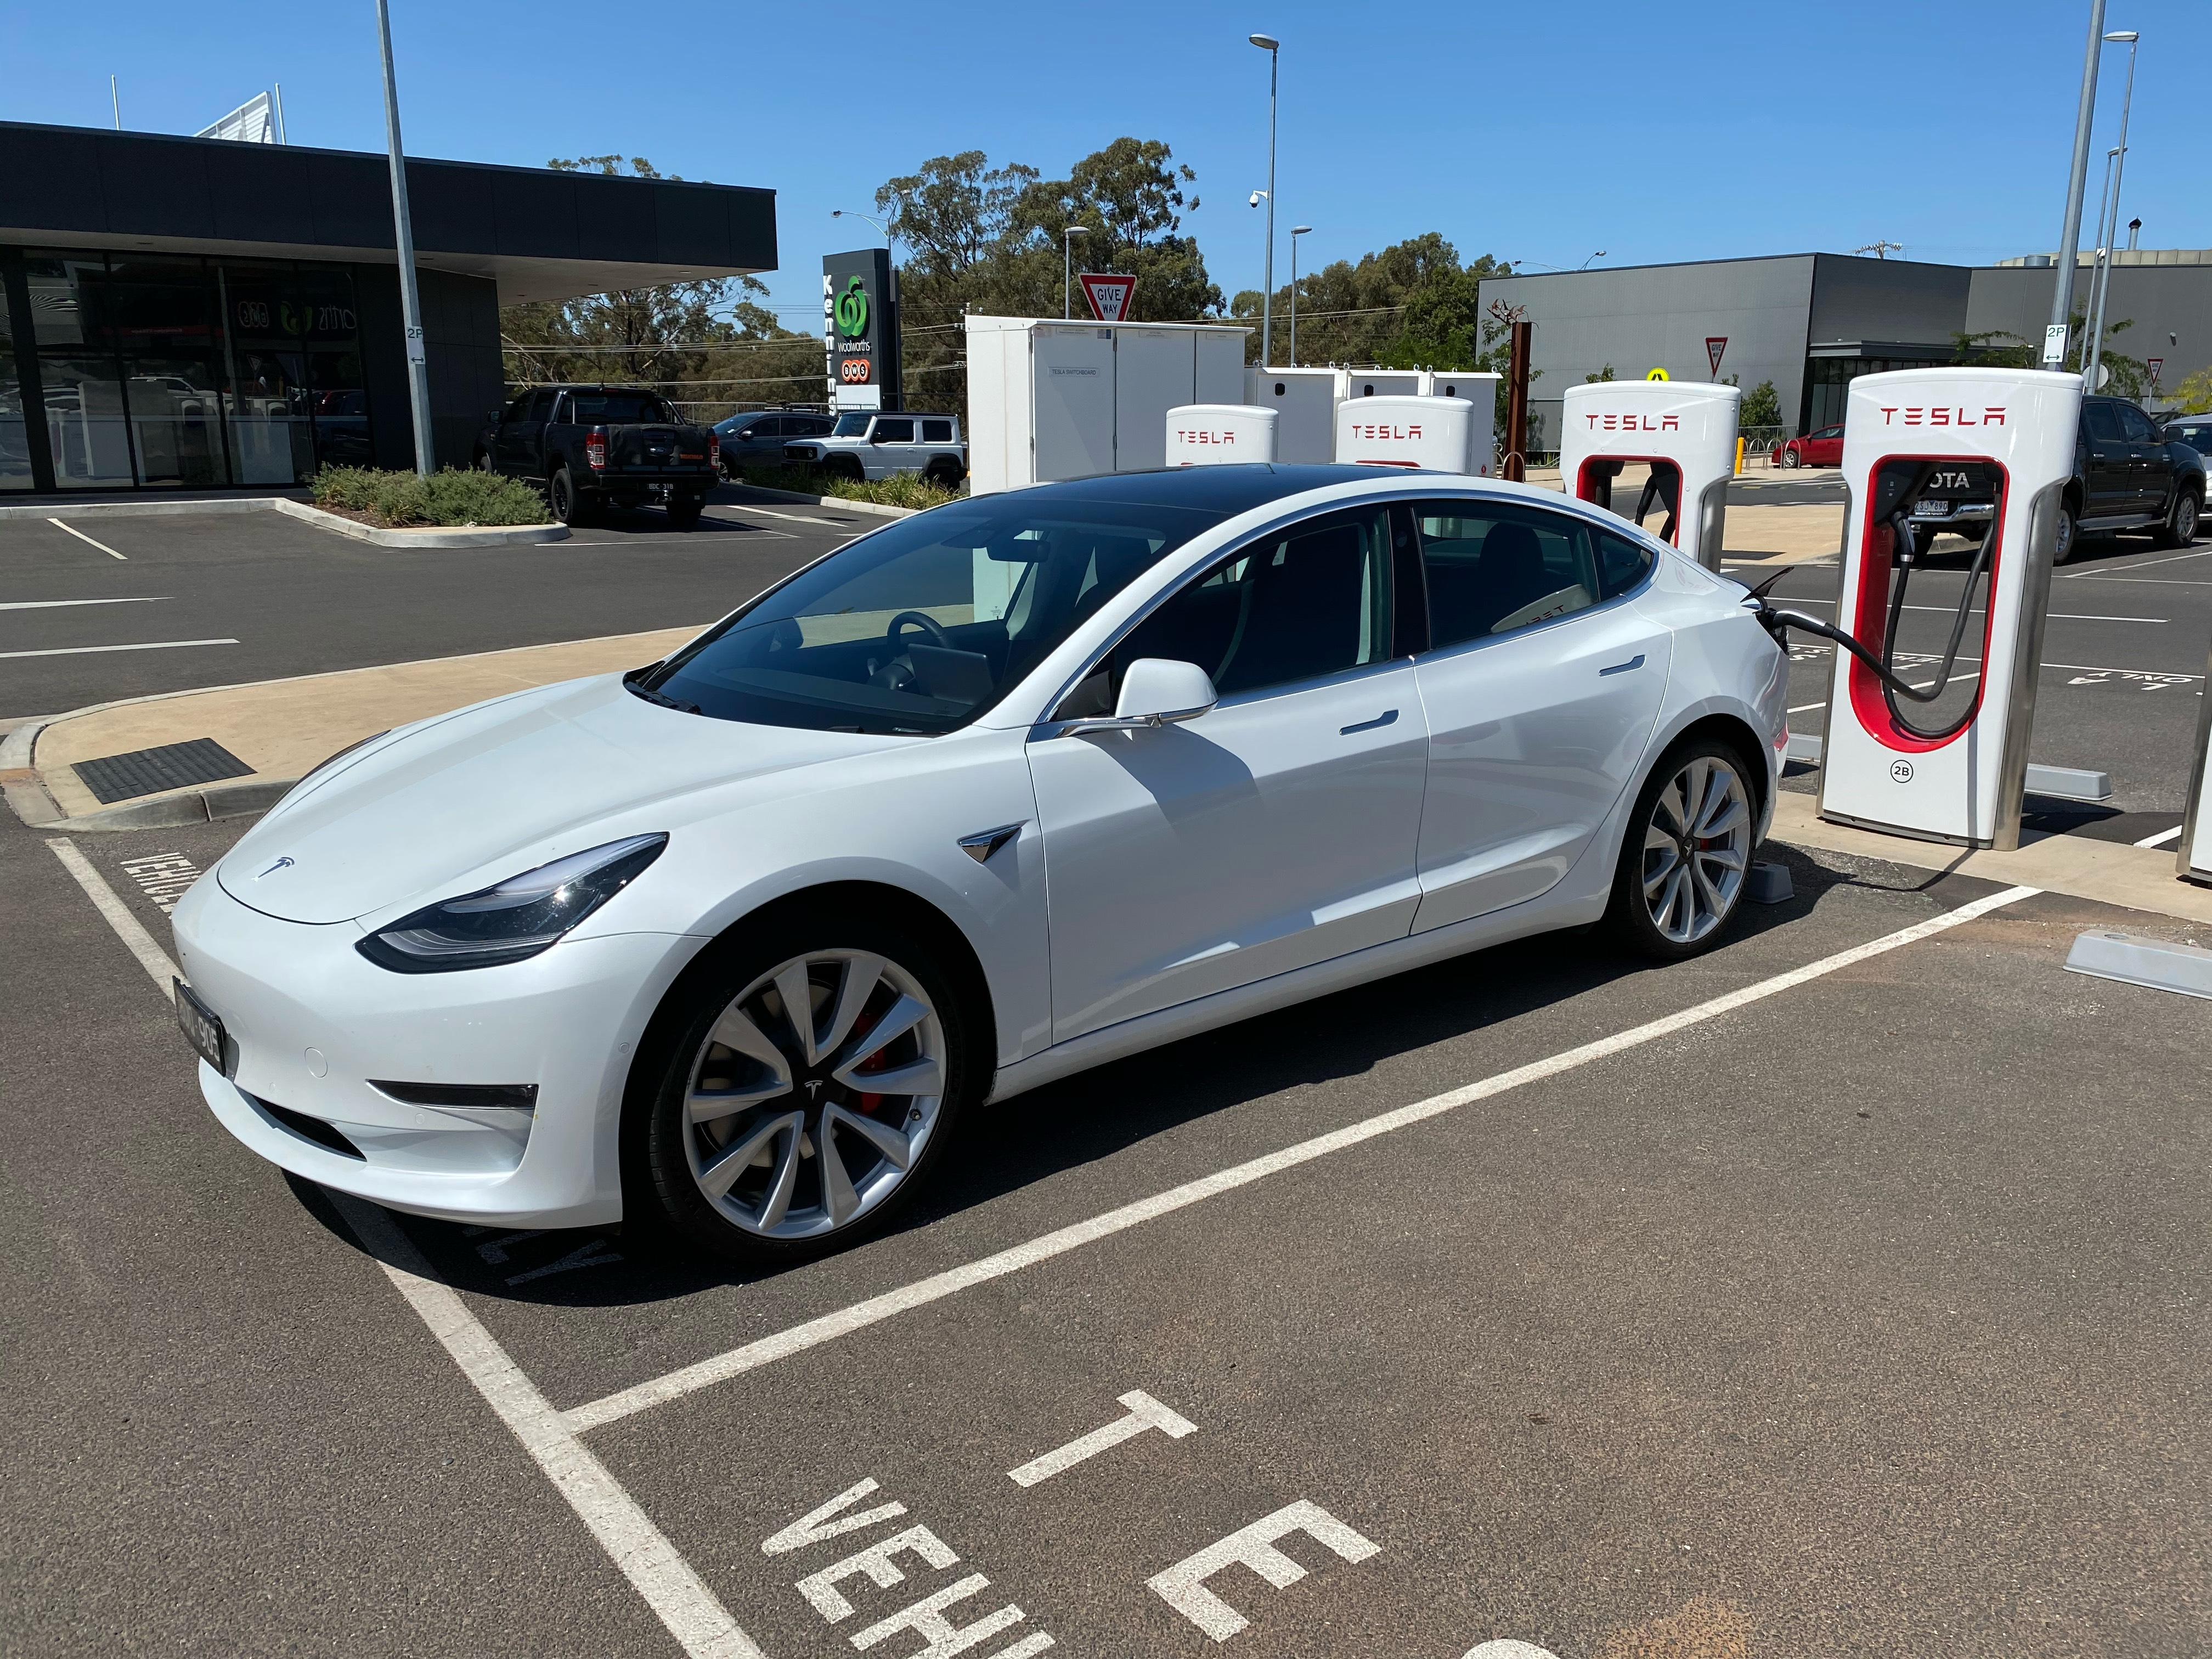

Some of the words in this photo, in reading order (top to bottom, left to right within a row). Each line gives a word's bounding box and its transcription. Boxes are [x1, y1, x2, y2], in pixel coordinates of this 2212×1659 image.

[1097, 289, 1121, 301] GIVE
[1102, 304, 1118, 314] WAY
[408, 328, 422, 338] 2P
[2048, 327, 2065, 337] 2P
[1585, 414, 1679, 431] TESLA
[1880, 407, 2006, 426] TESLA
[1178, 431, 1235, 444] TESLA
[1352, 425, 1422, 439] TESLA
[1894, 766, 1910, 776] 2B
